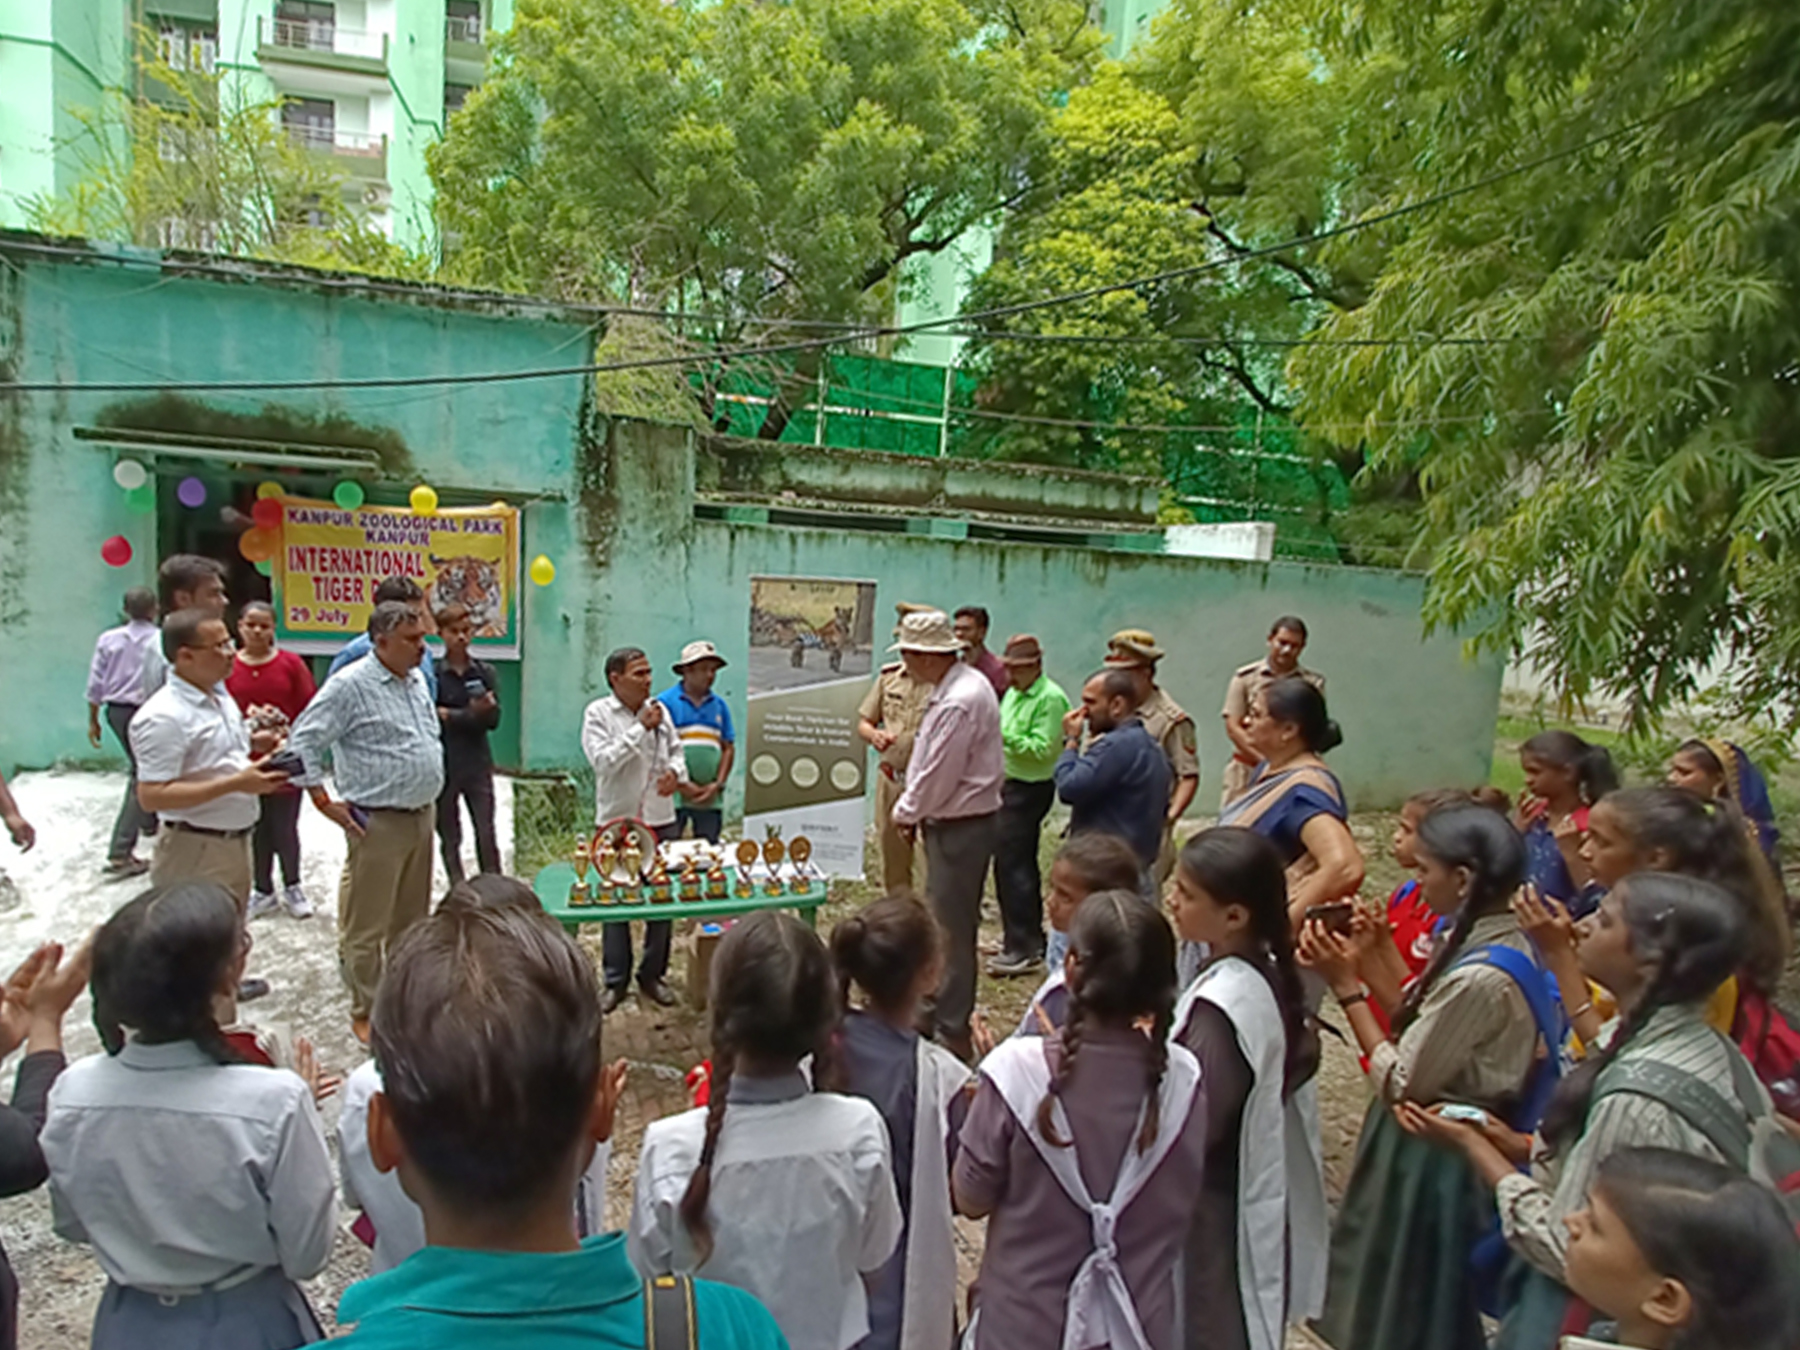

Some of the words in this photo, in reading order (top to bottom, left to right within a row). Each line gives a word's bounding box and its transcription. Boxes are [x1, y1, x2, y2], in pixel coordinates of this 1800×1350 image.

[287, 509, 353, 527] KANPUR
[359, 513, 458, 533] ZOOLOGICAL
[463, 519, 503, 534] PARK
[365, 530, 430, 546] KANPUR
[288, 547, 425, 577] INTERNATIONAL
[312, 576, 365, 603] TIGER
[290, 607, 310, 622] 29
[315, 608, 349, 625] July
